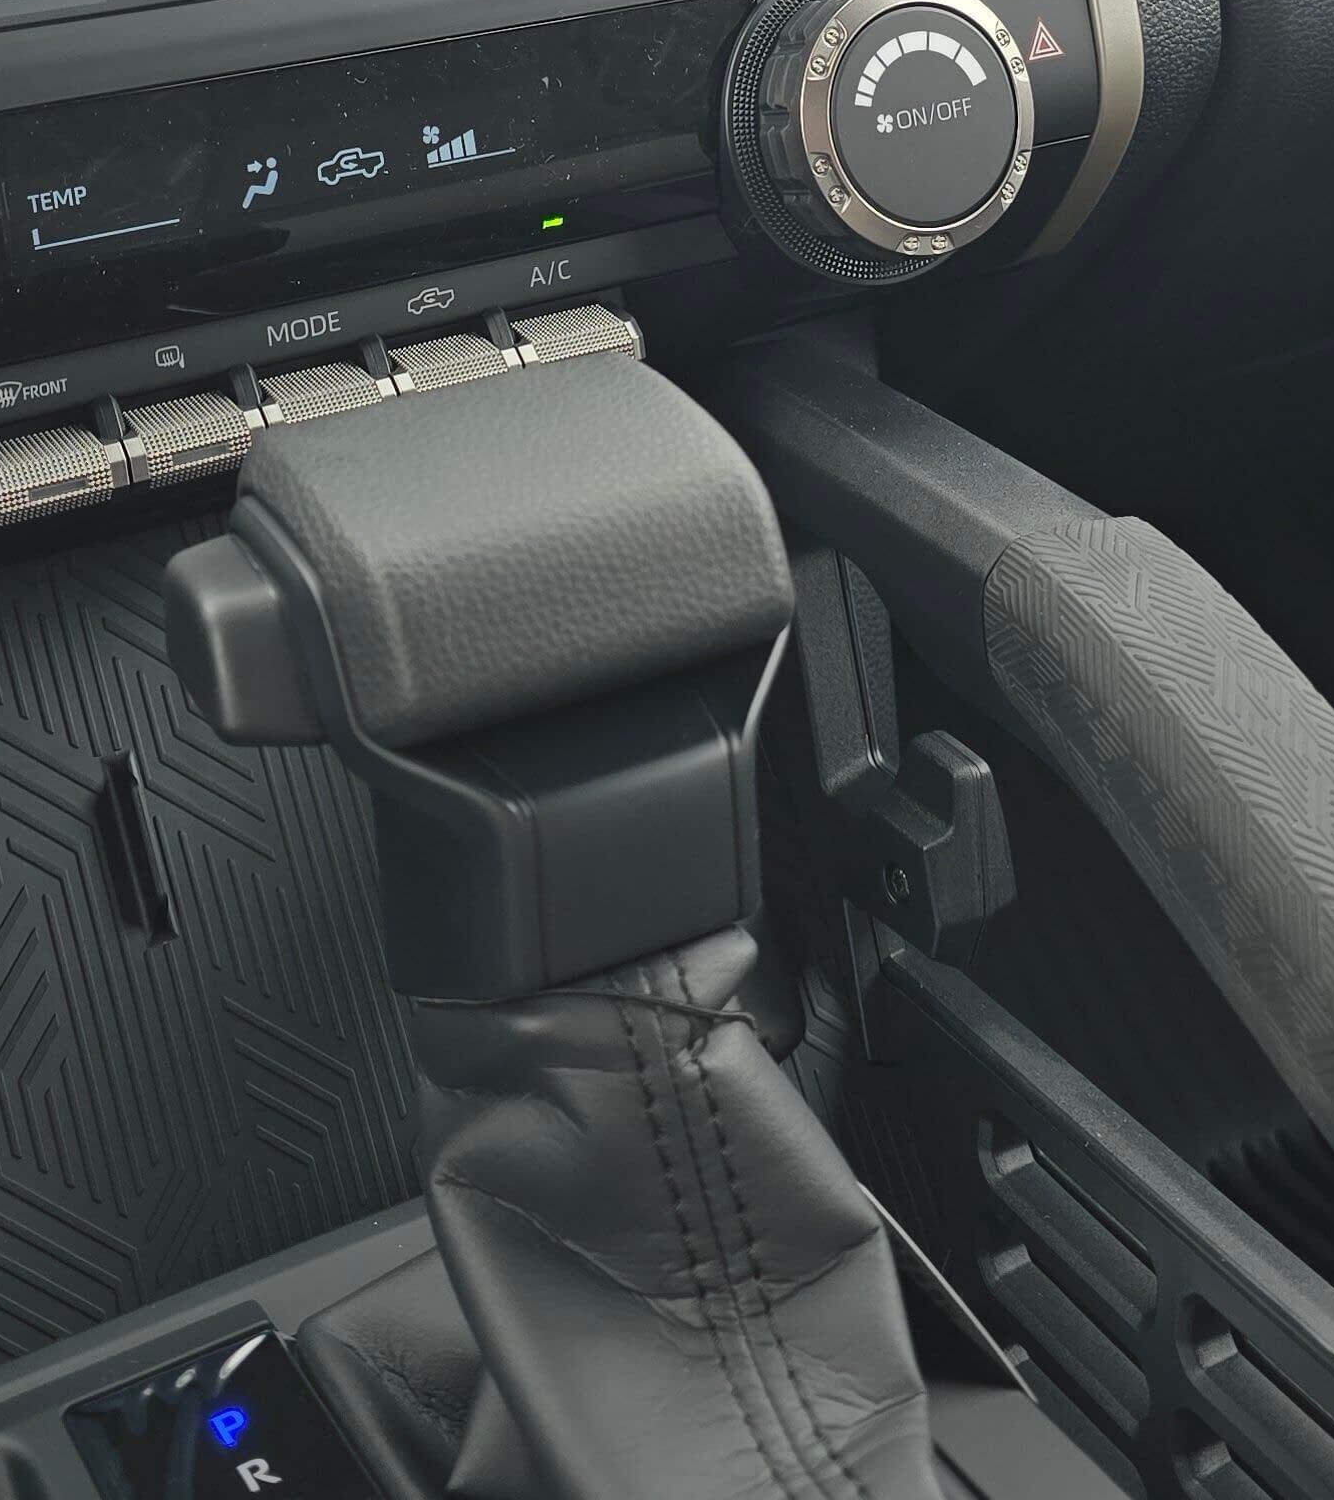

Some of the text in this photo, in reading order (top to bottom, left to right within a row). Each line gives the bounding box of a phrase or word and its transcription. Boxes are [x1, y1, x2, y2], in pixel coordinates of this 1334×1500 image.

[896, 97, 971, 131] ON/OFF
[27, 185, 87, 214] TEMP
[529, 260, 571, 288] A/C
[267, 311, 341, 346] MODE
[22, 377, 68, 401] FRONT
[210, 1408, 248, 1447] P
[236, 1457, 282, 1493] R
